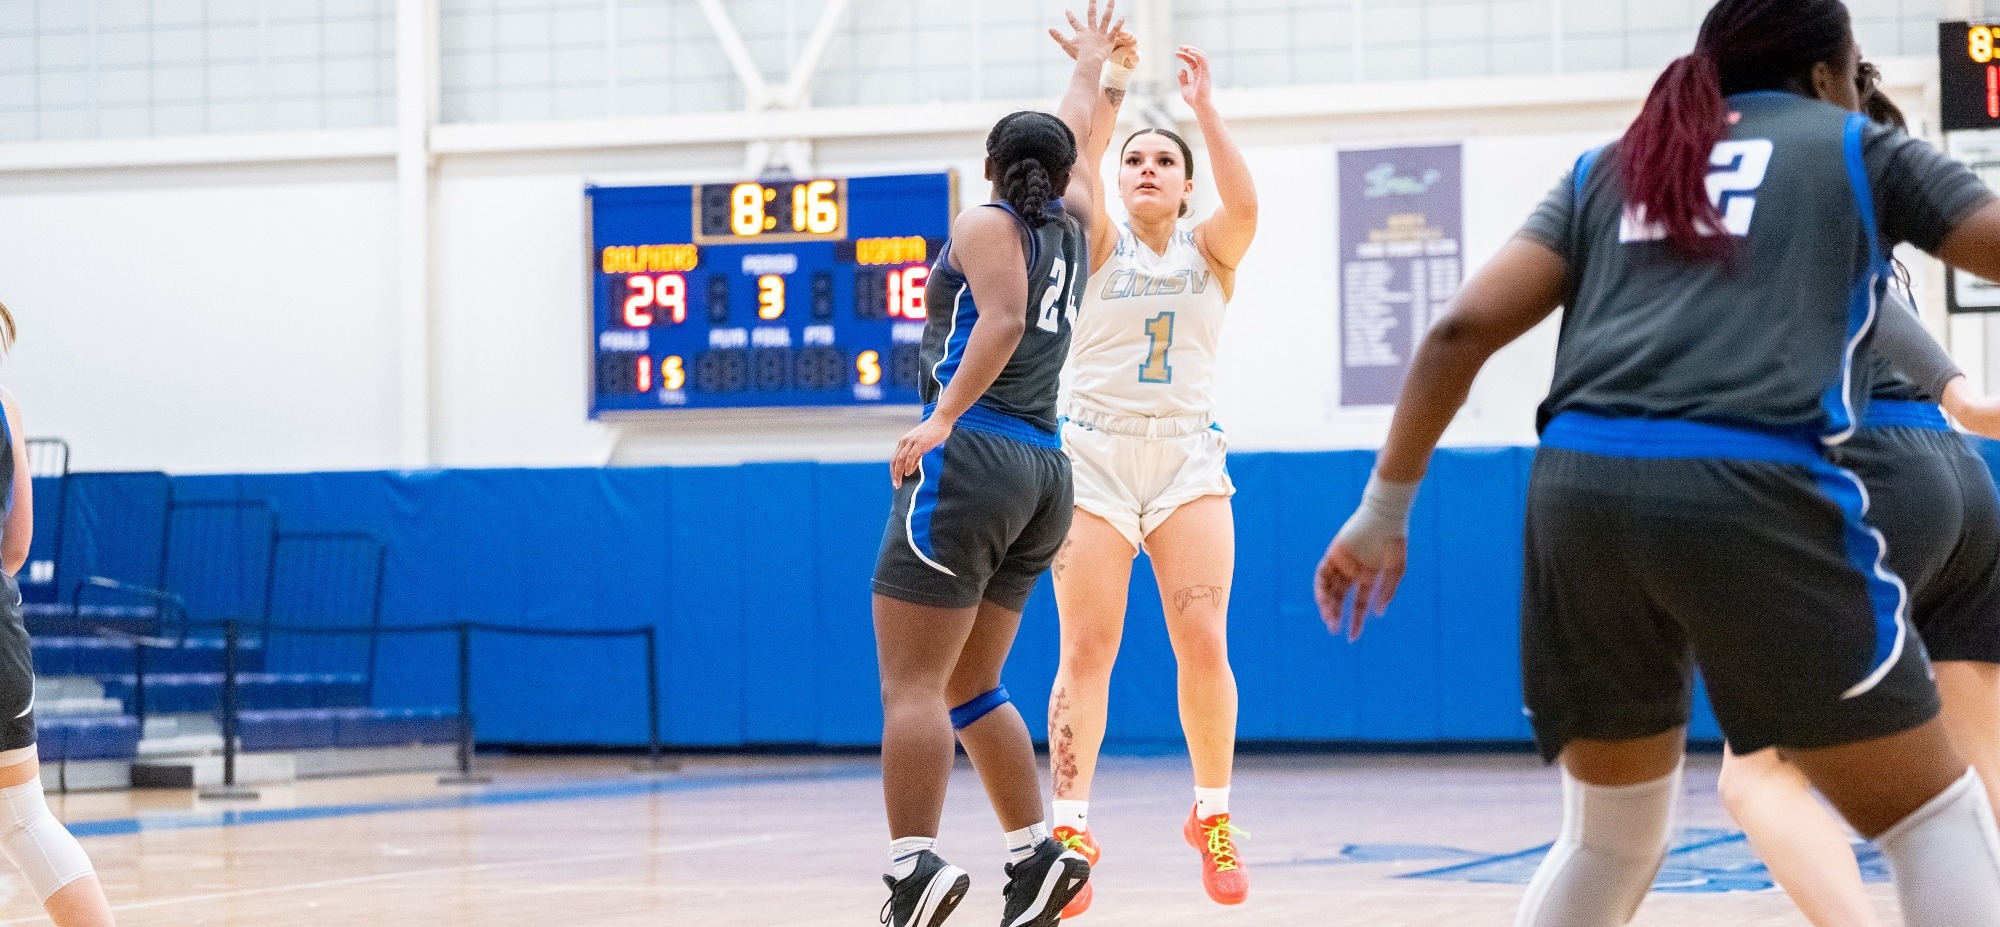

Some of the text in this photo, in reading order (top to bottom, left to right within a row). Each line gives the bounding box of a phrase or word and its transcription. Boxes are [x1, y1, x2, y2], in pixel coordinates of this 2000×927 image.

[731, 179, 838, 237] 8:16
[1619, 139, 1773, 243] 2
[624, 273, 687, 328] 29
[758, 274, 785, 320] 3
[887, 266, 930, 320] 16
[1101, 268, 1209, 300] CMSV
[636, 355, 652, 393] 1
[1138, 311, 1176, 384] 1
